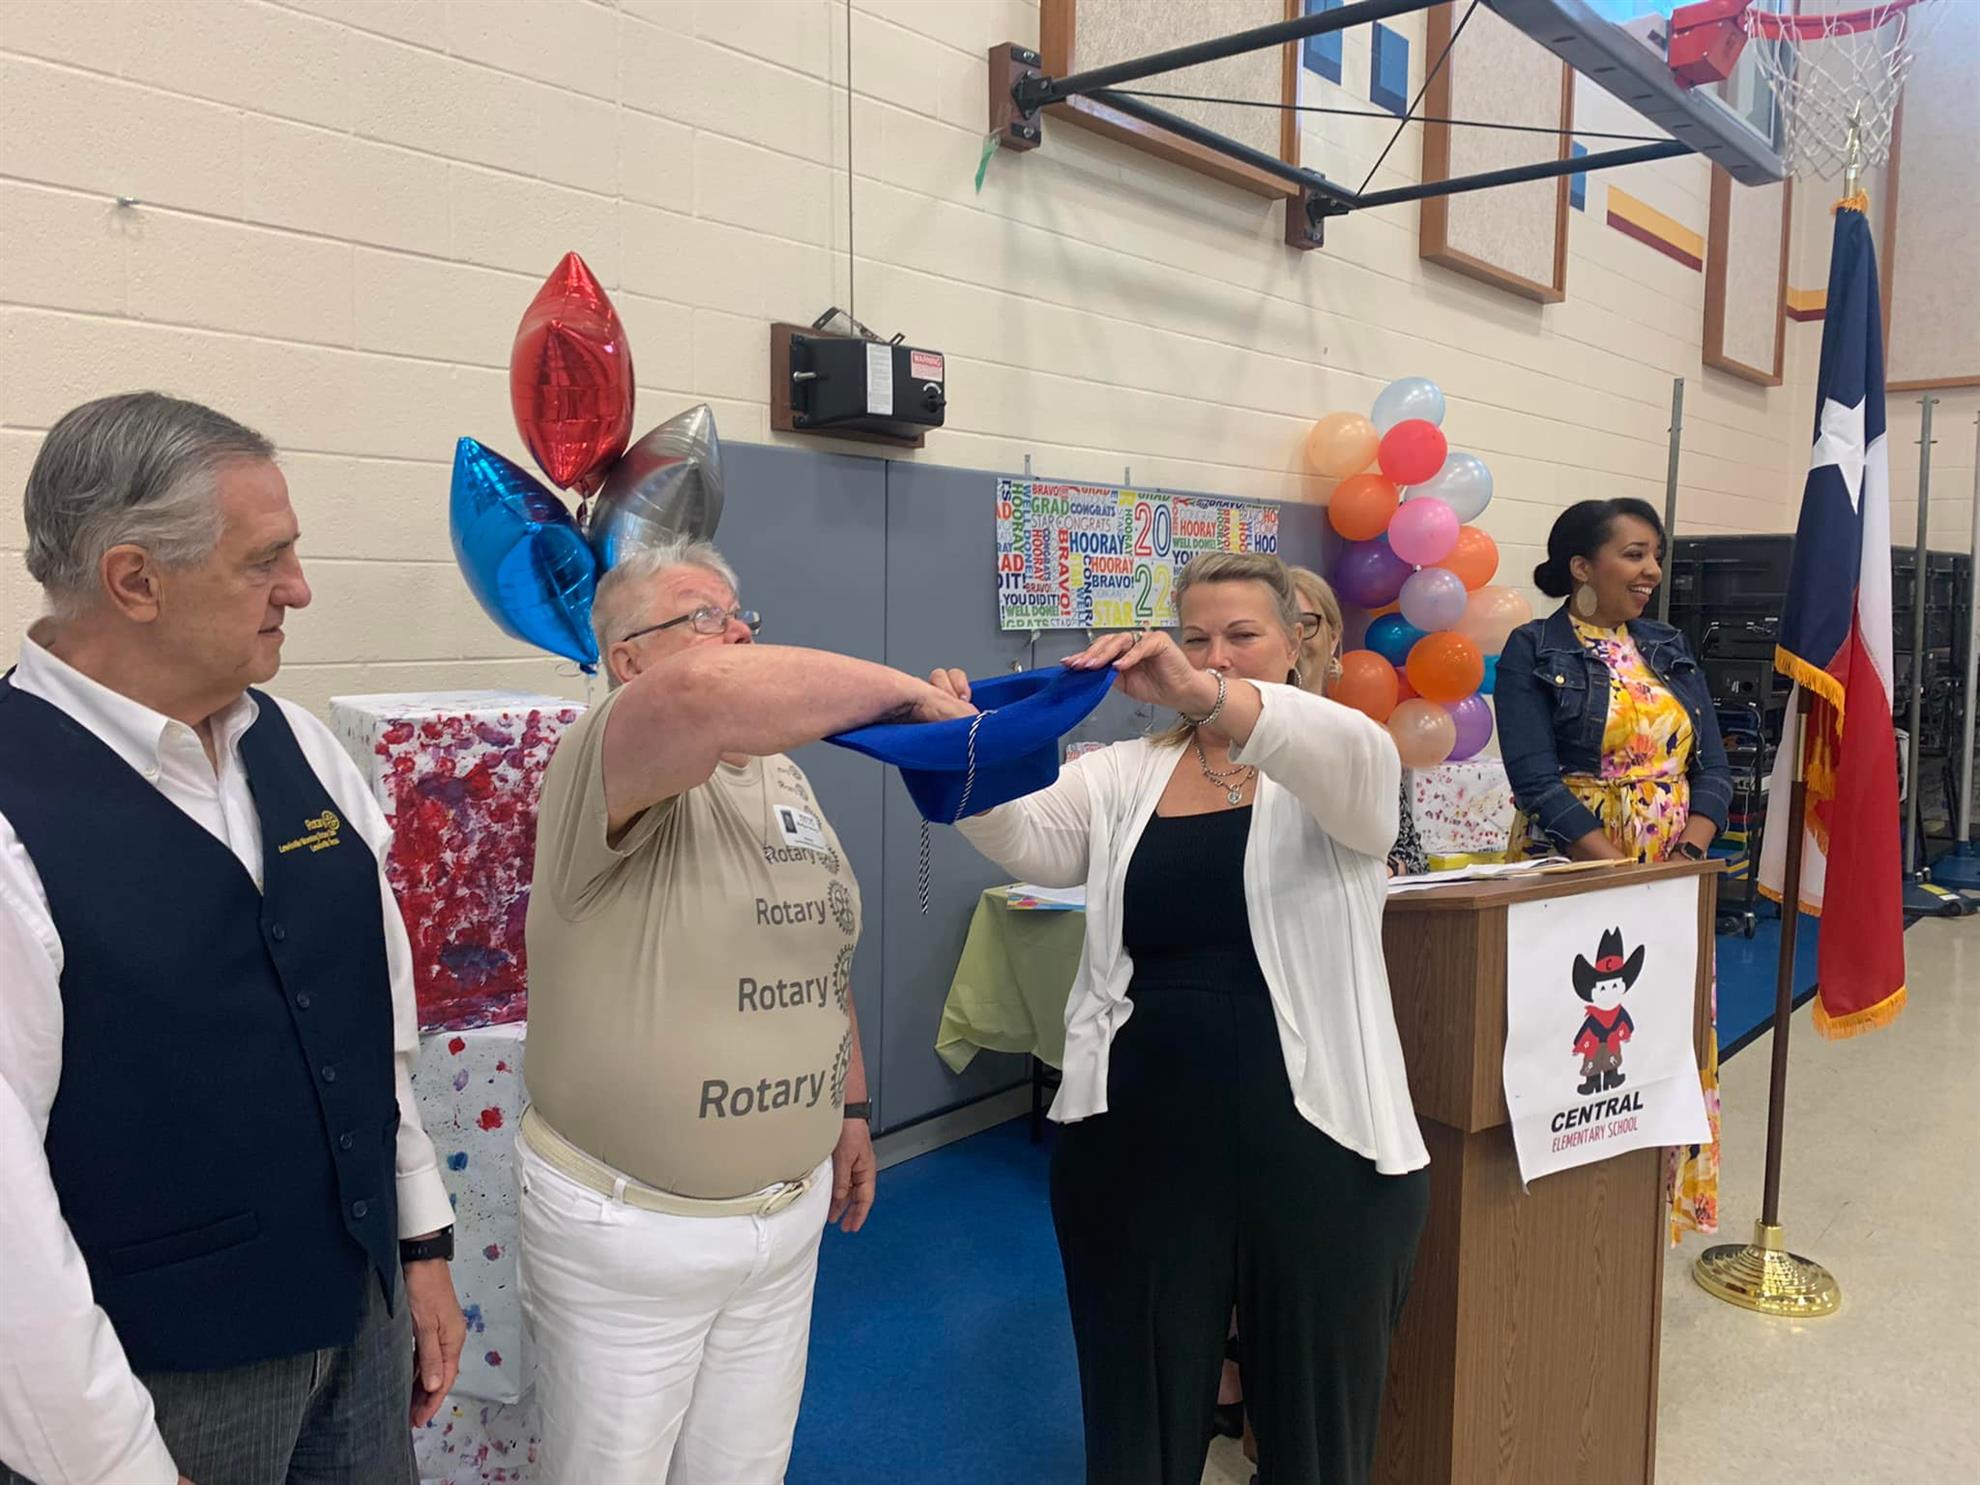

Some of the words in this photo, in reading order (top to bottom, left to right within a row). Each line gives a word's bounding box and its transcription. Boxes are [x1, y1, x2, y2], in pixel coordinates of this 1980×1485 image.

[1012, 483, 1024, 553] HOORAY
[1032, 497, 1069, 515] GRAD
[1071, 503, 1115, 517] CONGRATS
[1070, 531, 1125, 555] HOORAY
[1125, 509, 1133, 556] HOORAY
[1135, 502, 1171, 557] 20
[1172, 538, 1192, 549] WELL
[1180, 520, 1217, 538] HOORAY
[1033, 529, 1044, 581] HOORAY
[1091, 556, 1134, 574] HOORAY
[1058, 528, 1071, 616] BRAVO!
[1092, 575, 1134, 589] BRAVO!
[1003, 594, 1027, 606] YOU
[1135, 564, 1172, 617] 22
[1007, 606, 1030, 617] WELL
[766, 845, 816, 865] Rotary
[756, 897, 827, 926] Rotary
[738, 976, 829, 1013] Rotary
[699, 1070, 826, 1118] Rotary
[1551, 1091, 1644, 1133] CENTRAL
[1552, 1124, 1606, 1153] ELEMENTARY
[1608, 1116, 1638, 1138] SCHOOL
